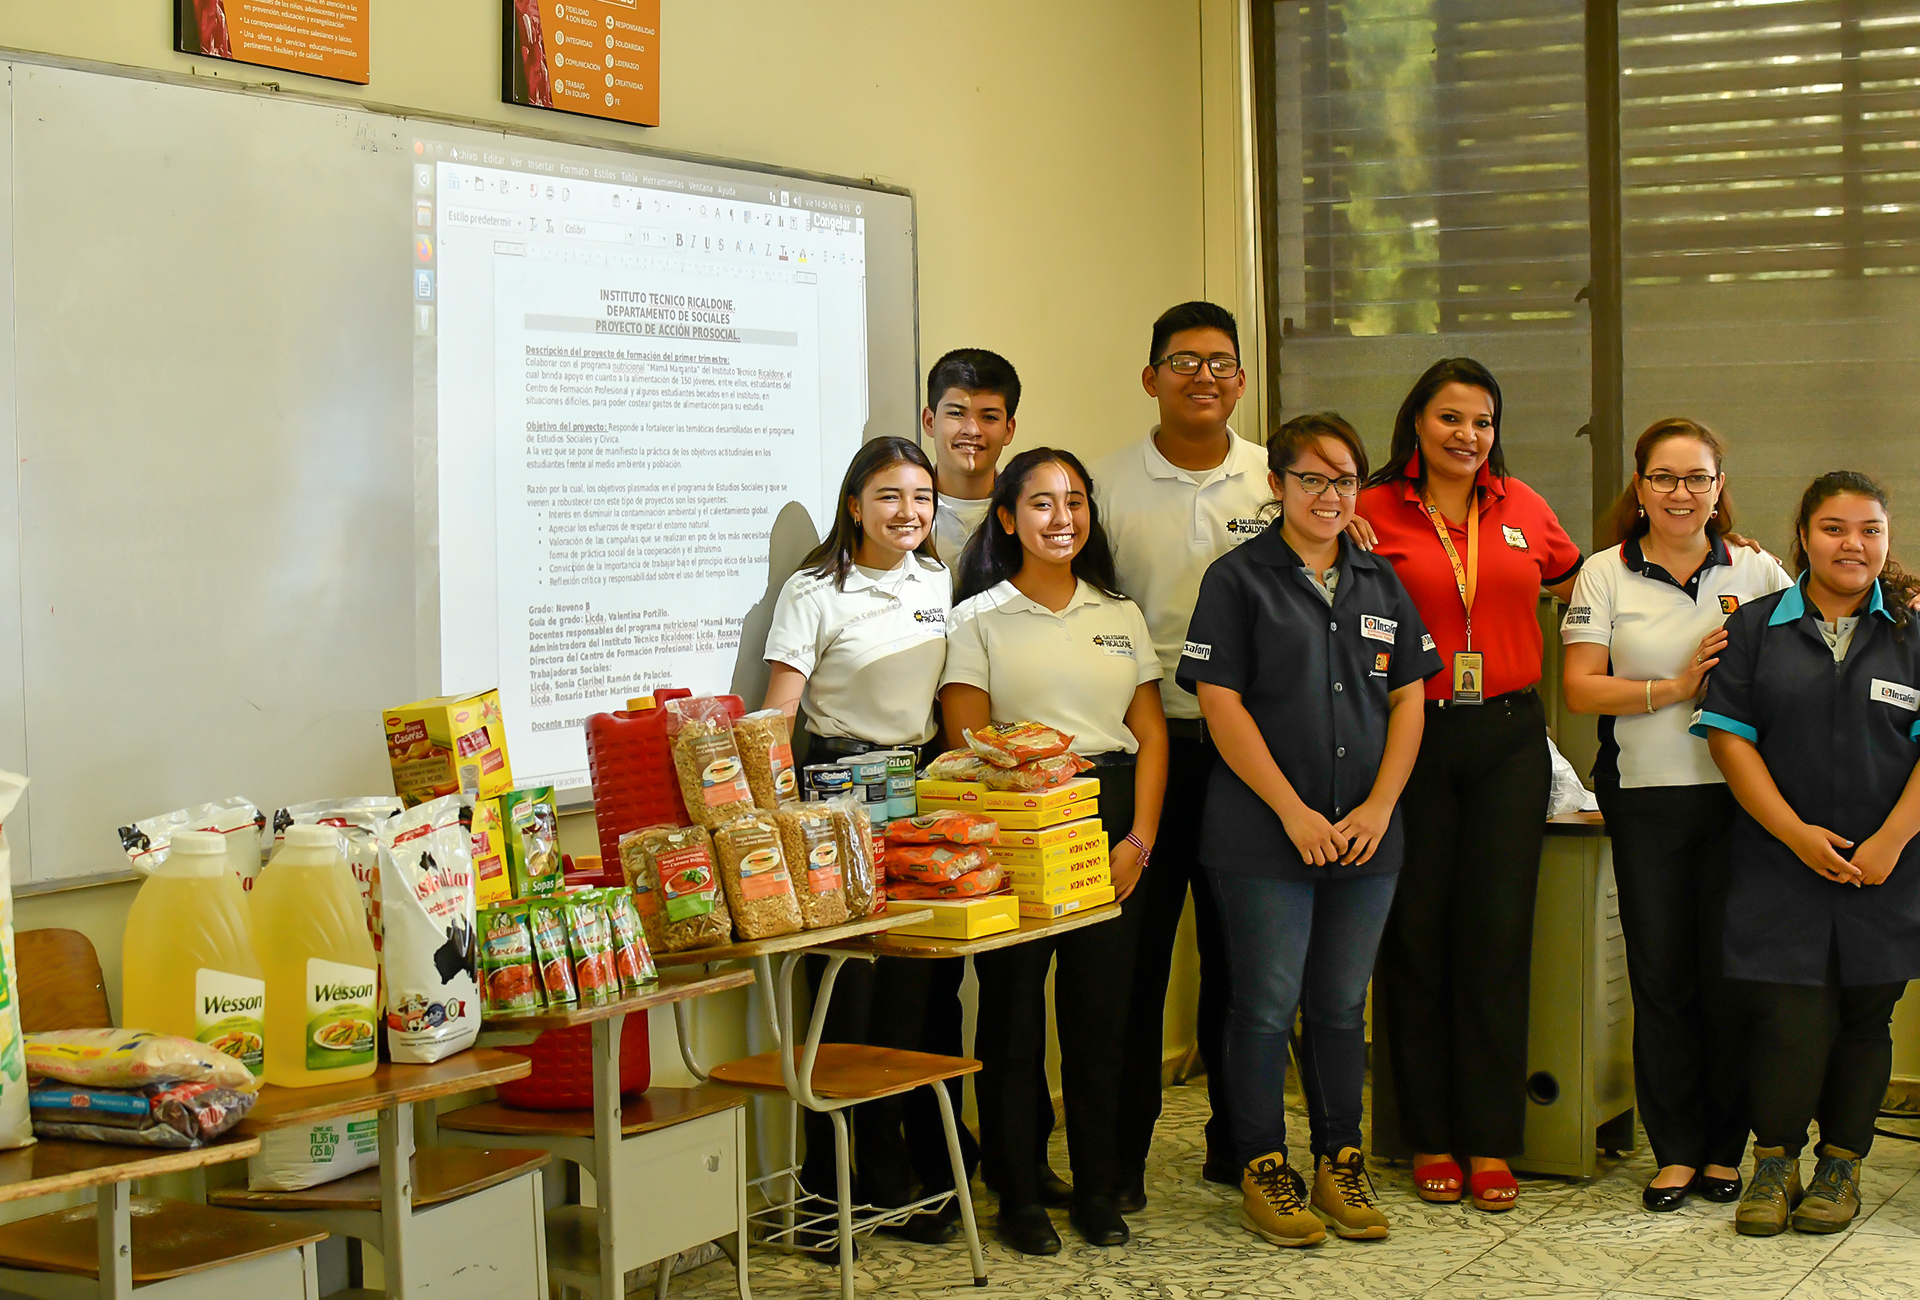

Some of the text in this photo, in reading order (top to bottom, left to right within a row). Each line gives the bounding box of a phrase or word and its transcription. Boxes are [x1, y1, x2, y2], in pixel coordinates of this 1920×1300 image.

[566, 5, 589, 16] FIDELIDAD
[581, 18, 597, 28] BOSCO
[616, 21, 655, 35] RESPONSABILIDAD
[251, 19, 296, 33] corresponsabilidad
[311, 30, 333, 40] salesianos
[339, 35, 352, 43] laicos.
[244, 30, 254, 38] Una
[258, 33, 272, 41] oferta
[286, 38, 306, 48] servicios
[309, 43, 357, 57] educativo-pastorales
[566, 36, 593, 48] INTEGRIDAD
[615, 40, 644, 52] SOLIDARIDAD
[274, 46, 294, 56] flexibles
[306, 52, 324, 60] calidad.
[615, 59, 639, 70] LIDERAZGO
[566, 80, 585, 90] TRABAJO
[615, 79, 643, 90] CREATIVIDAD
[573, 90, 590, 99] EQUIPO
[484, 153, 505, 164] Editar
[511, 157, 522, 167] Ver
[528, 160, 554, 171] Insertar
[561, 164, 589, 176] Formato
[594, 168, 616, 180] Estilos
[621, 172, 637, 182] Tabla
[643, 175, 684, 189] Herramientas
[689, 181, 713, 193] Ventana
[718, 186, 735, 196] Ayuda
[821, 200, 828, 209] de
[829, 201, 837, 210] feb
[839, 204, 850, 212] 9:15
[449, 211, 468, 222] Estilo
[814, 213, 851, 230] Congelar
[565, 224, 586, 234] Calibri
[600, 289, 735, 311] INSTITUTO TECNICO RICALDONE.
[606, 305, 730, 324] DEPARTAMENTO DE SOCIALES
[595, 322, 740, 340] PROYECTO DE ACCIÓN PROSOCIAL.
[525, 345, 729, 364] Descripción del proyecto de formación del primer trimestre:
[526, 421, 557, 433] Objetivo
[559, 422, 571, 431] del
[572, 422, 606, 434] proyecto:
[608, 422, 638, 434] Responde
[645, 423, 674, 432] fortalecer
[675, 424, 684, 433] las
[685, 424, 714, 433] temáticas
[715, 424, 752, 434] desarrolladas
[762, 425, 767, 434] el
[768, 427, 794, 437] programa
[526, 459, 682, 470] estudiantes frente al medio ambiente y población.
[548, 519, 710, 535] Apreciar los esfuerzos de respetar el entorno natural.
[528, 602, 590, 614] Grado: Noveno B
[528, 617, 545, 627] Guía
[547, 616, 556, 626] de
[559, 614, 583, 627] grado:
[608, 610, 640, 621] Valentina
[643, 608, 669, 619] Portillo.
[530, 663, 611, 681] Trabajadoras Sociales:
[554, 678, 575, 689] Sonia
[577, 676, 604, 687] Claribel
[606, 673, 631, 684] Ramón
[632, 672, 641, 682] de
[643, 669, 672, 681] Palacios.
[395, 730, 424, 744] Caseras
[556, 777, 584, 787] caracteres
[821, 772, 848, 780] Splash
[521, 883, 528, 892] 12
[533, 880, 554, 892] Sopas
[315, 984, 372, 1002] Wesson
[205, 996, 262, 1014] Wesson
[310, 1133, 339, 1144] 11.35 kg
[311, 1145, 334, 1157] (25 lb)
